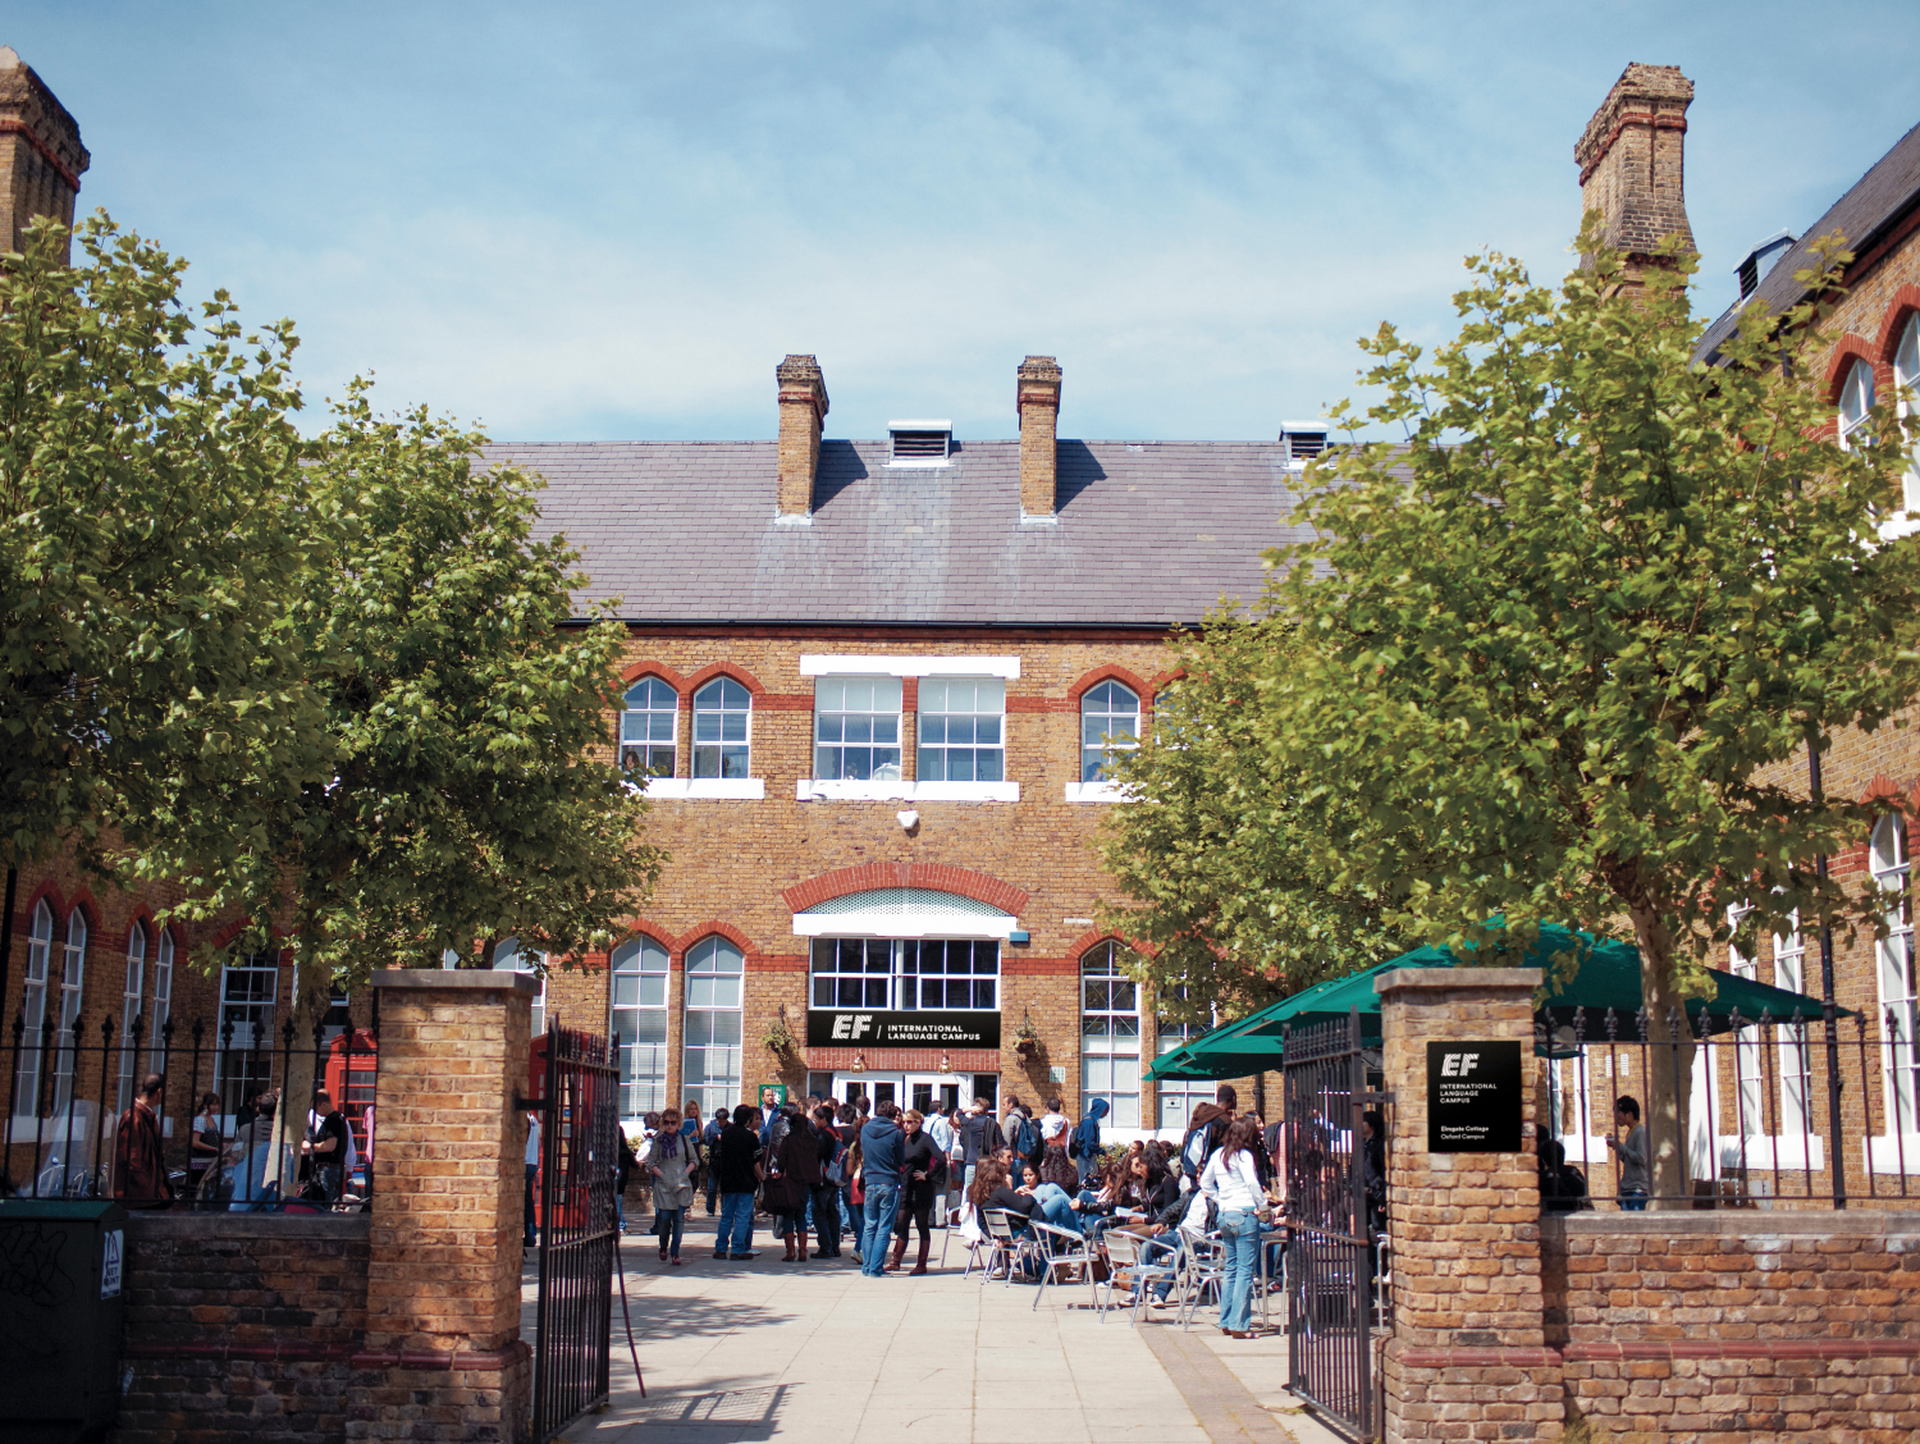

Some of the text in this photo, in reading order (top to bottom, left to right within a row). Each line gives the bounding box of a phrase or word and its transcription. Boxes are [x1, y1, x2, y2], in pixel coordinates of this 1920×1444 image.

[831, 1014, 872, 1039] EF
[1441, 1053, 1480, 1076] EF
[1462, 1133, 1485, 1141] Campus
